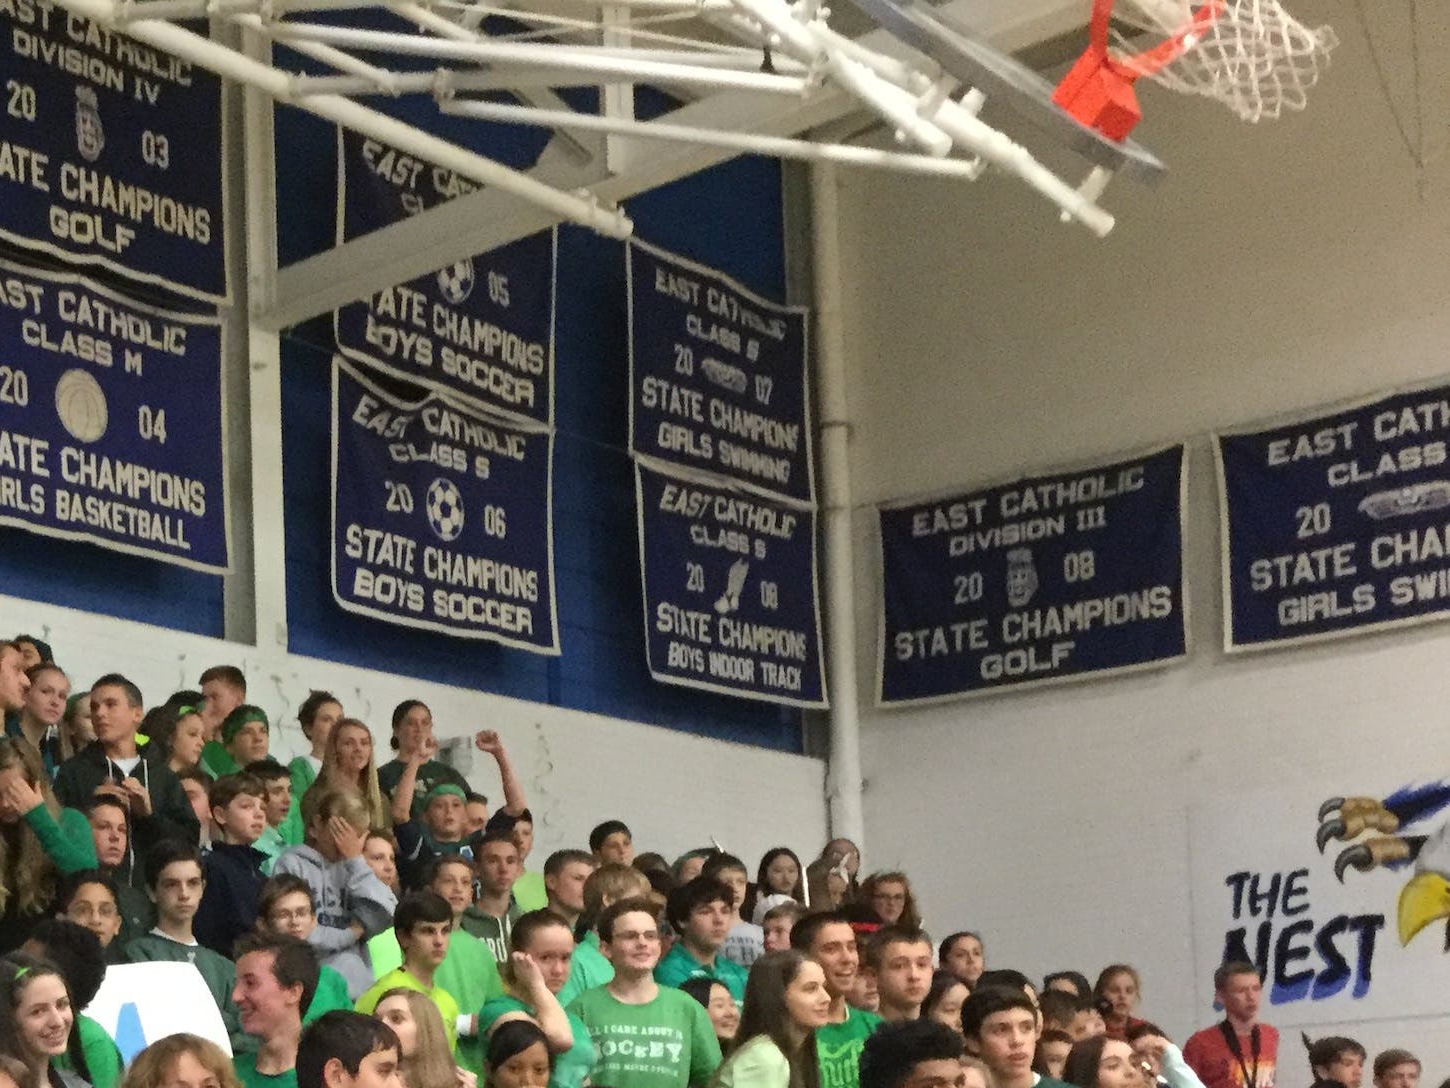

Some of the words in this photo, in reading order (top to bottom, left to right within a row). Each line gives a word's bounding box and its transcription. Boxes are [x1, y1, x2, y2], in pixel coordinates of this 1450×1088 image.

[12, 28, 125, 93] DIVISION
[134, 76, 161, 106] IV
[6, 79, 37, 122] 20
[141, 129, 170, 170] 03
[362, 139, 425, 190] EAST
[50, 205, 136, 254] GOLF
[60, 161, 211, 245] CHAMPIONS
[654, 267, 700, 306] EAST
[22, 318, 113, 368] CLASS
[124, 347, 143, 377] M
[58, 290, 187, 356] CATHOLIC
[368, 285, 428, 329] ATE
[432, 301, 544, 377] CHAMPIONS
[440, 345, 535, 408] SOCCER
[674, 342, 694, 377] 20
[138, 404, 167, 445] 04
[351, 393, 411, 440] EAST
[421, 406, 526, 462] CATHOLIC
[641, 375, 704, 424] STATE
[708, 397, 800, 453] CHAMPIONS
[656, 420, 714, 460] GIRLS
[1267, 420, 1359, 467] EAST
[60, 446, 206, 518] CHAMPIONS
[388, 442, 468, 474] CLASS
[1326, 440, 1448, 488] CLASS
[55, 488, 191, 550] BASKETBALL
[384, 480, 415, 514] 20
[483, 504, 506, 540] 06
[659, 482, 712, 519] EAST
[713, 496, 797, 542] CATHOLIC
[912, 498, 987, 537] EAST
[999, 466, 1145, 519] CATHOLIC
[950, 513, 1065, 558] DIVISION
[1075, 504, 1107, 533] III
[1295, 502, 1332, 539] 20
[344, 523, 417, 575] STATE
[422, 545, 539, 603] CHAMPIONS
[686, 560, 705, 593] 20
[952, 570, 983, 606] 20
[1063, 550, 1096, 584] 08
[1250, 542, 1358, 592] STATE
[352, 566, 425, 613] BOYS
[431, 588, 534, 635] SOCCER
[893, 617, 990, 661] STATE
[1001, 584, 1173, 643] CHAMPIONS
[1277, 583, 1377, 627] GIRLS
[656, 601, 712, 645] STATE
[718, 616, 807, 662] CHAMPIONS
[979, 640, 1076, 681] GOLF
[667, 640, 705, 673] BOYS
[708, 650, 755, 684] INDOOR
[759, 662, 802, 692] TRACK
[1224, 867, 1311, 920] THE
[1212, 913, 1386, 1012] NEST
